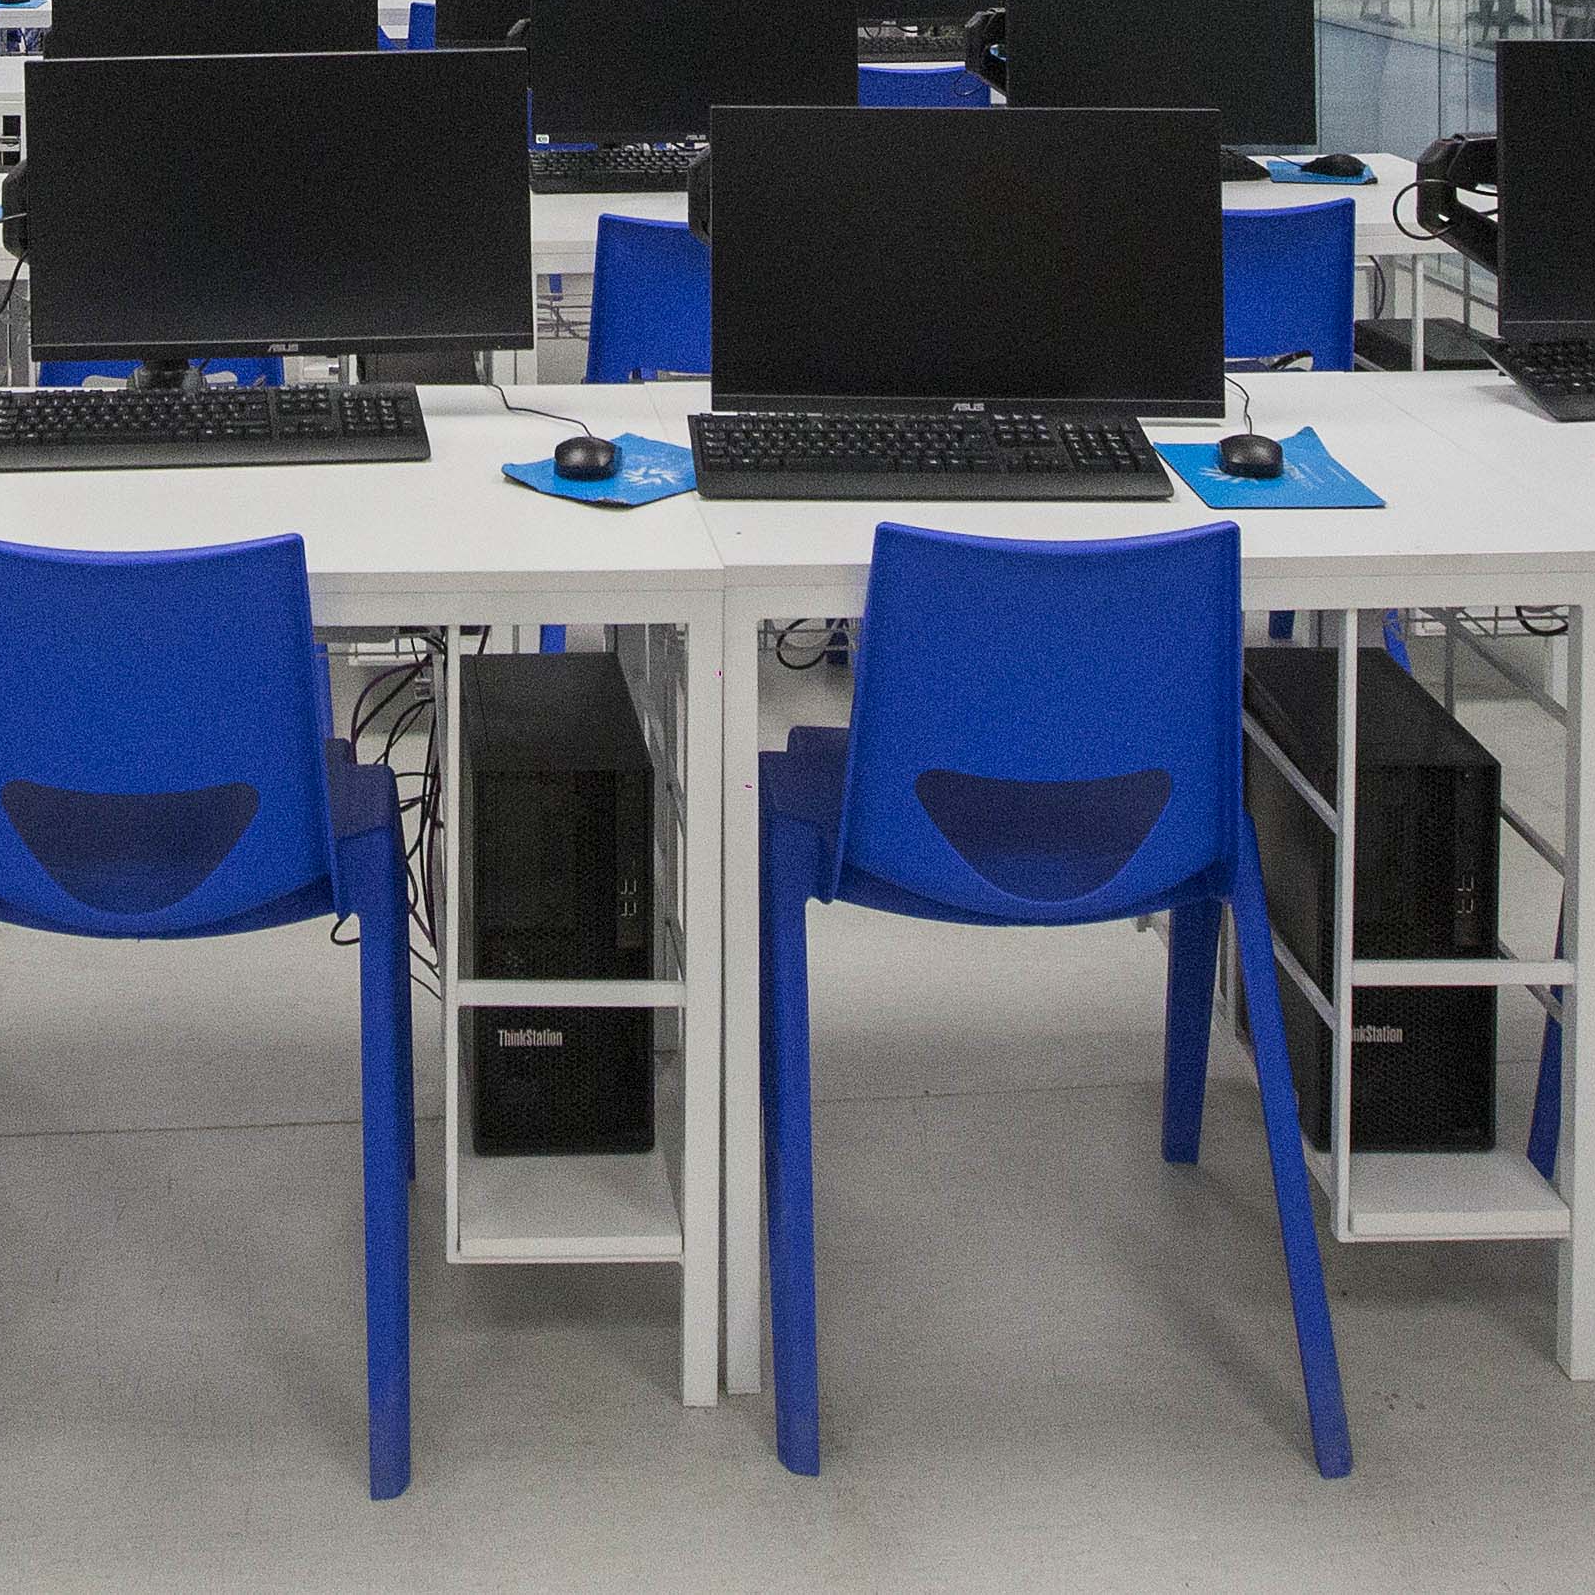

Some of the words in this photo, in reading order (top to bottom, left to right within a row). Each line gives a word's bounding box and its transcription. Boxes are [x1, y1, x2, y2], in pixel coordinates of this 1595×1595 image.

[267, 343, 299, 352] ASUS
[952, 402, 985, 412] ASUS
[498, 1028, 563, 1047] ThinkStation
[1352, 1024, 1403, 1043] nkStation
